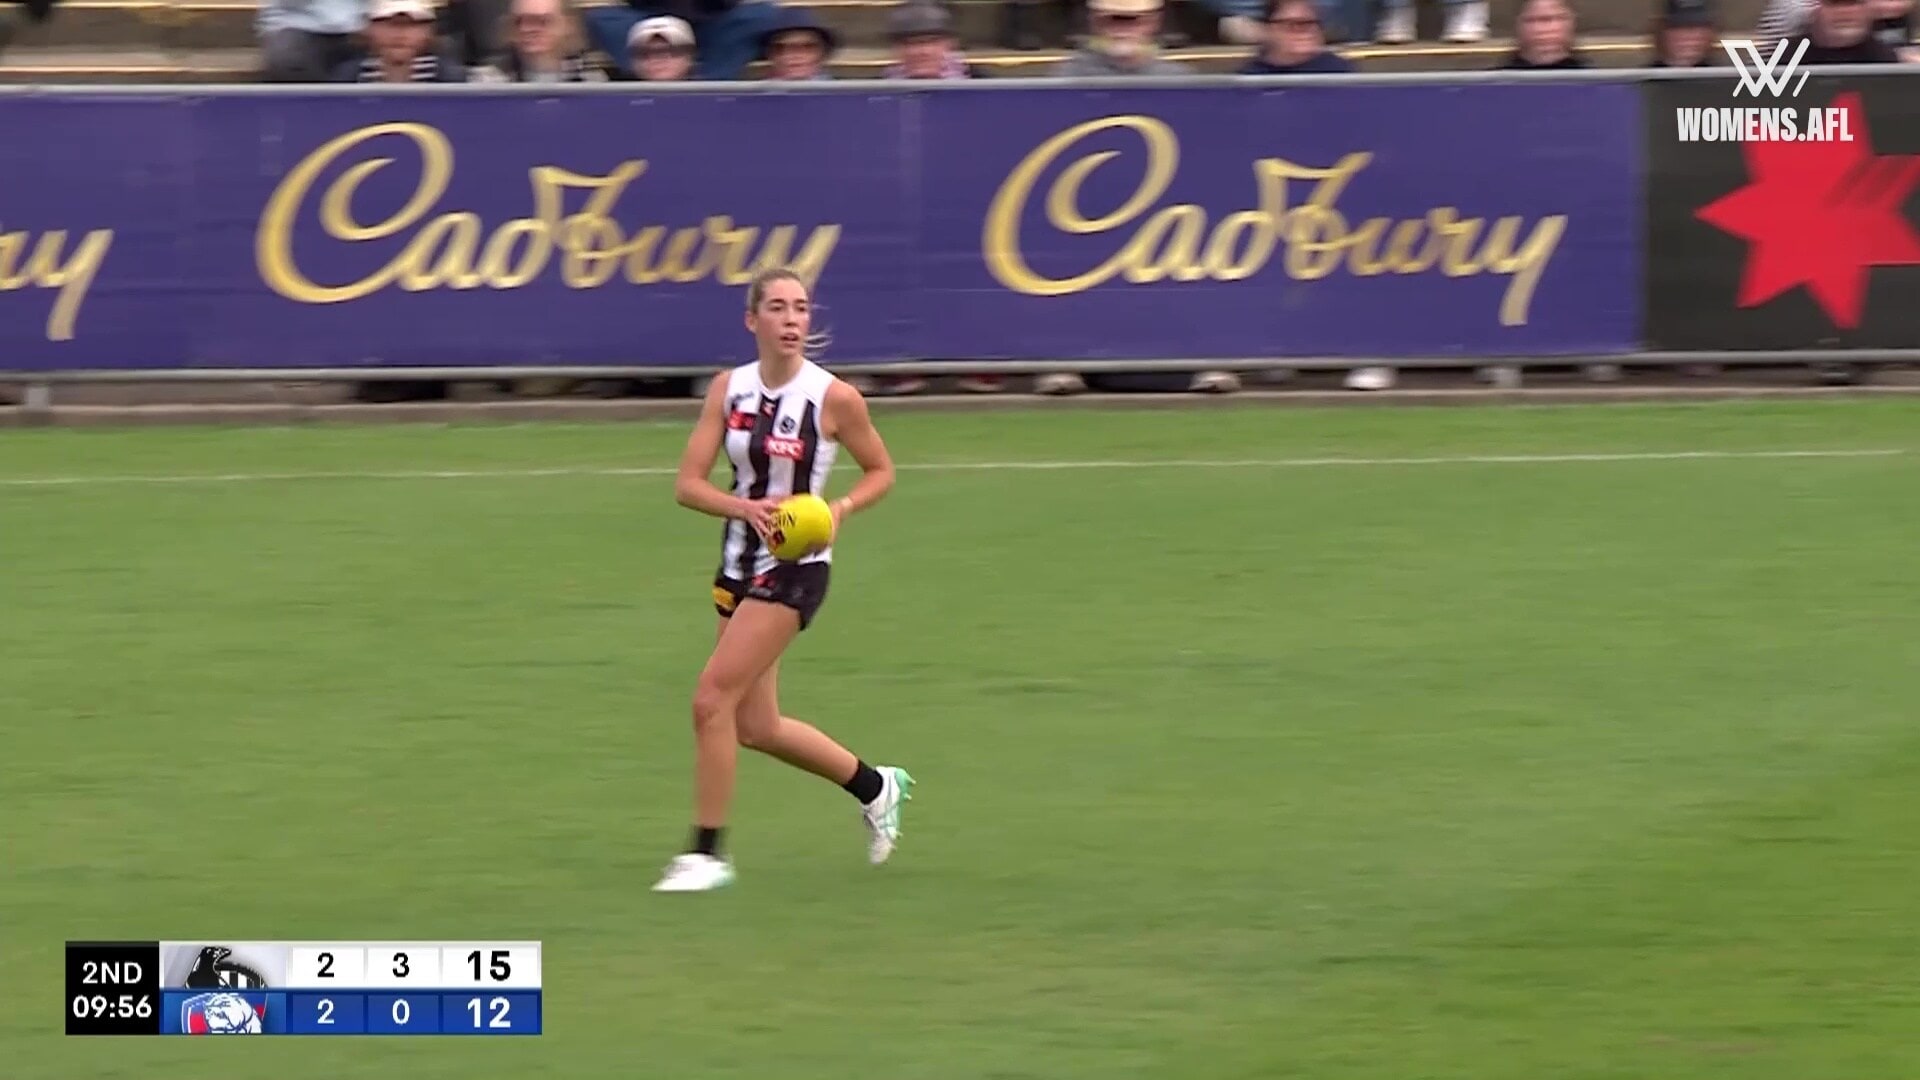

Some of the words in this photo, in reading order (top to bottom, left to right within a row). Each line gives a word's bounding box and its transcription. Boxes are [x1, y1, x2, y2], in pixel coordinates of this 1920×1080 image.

[257, 121, 842, 304] Cadbury
[984, 115, 1567, 326] Cadbury
[767, 440, 803, 457] KFC
